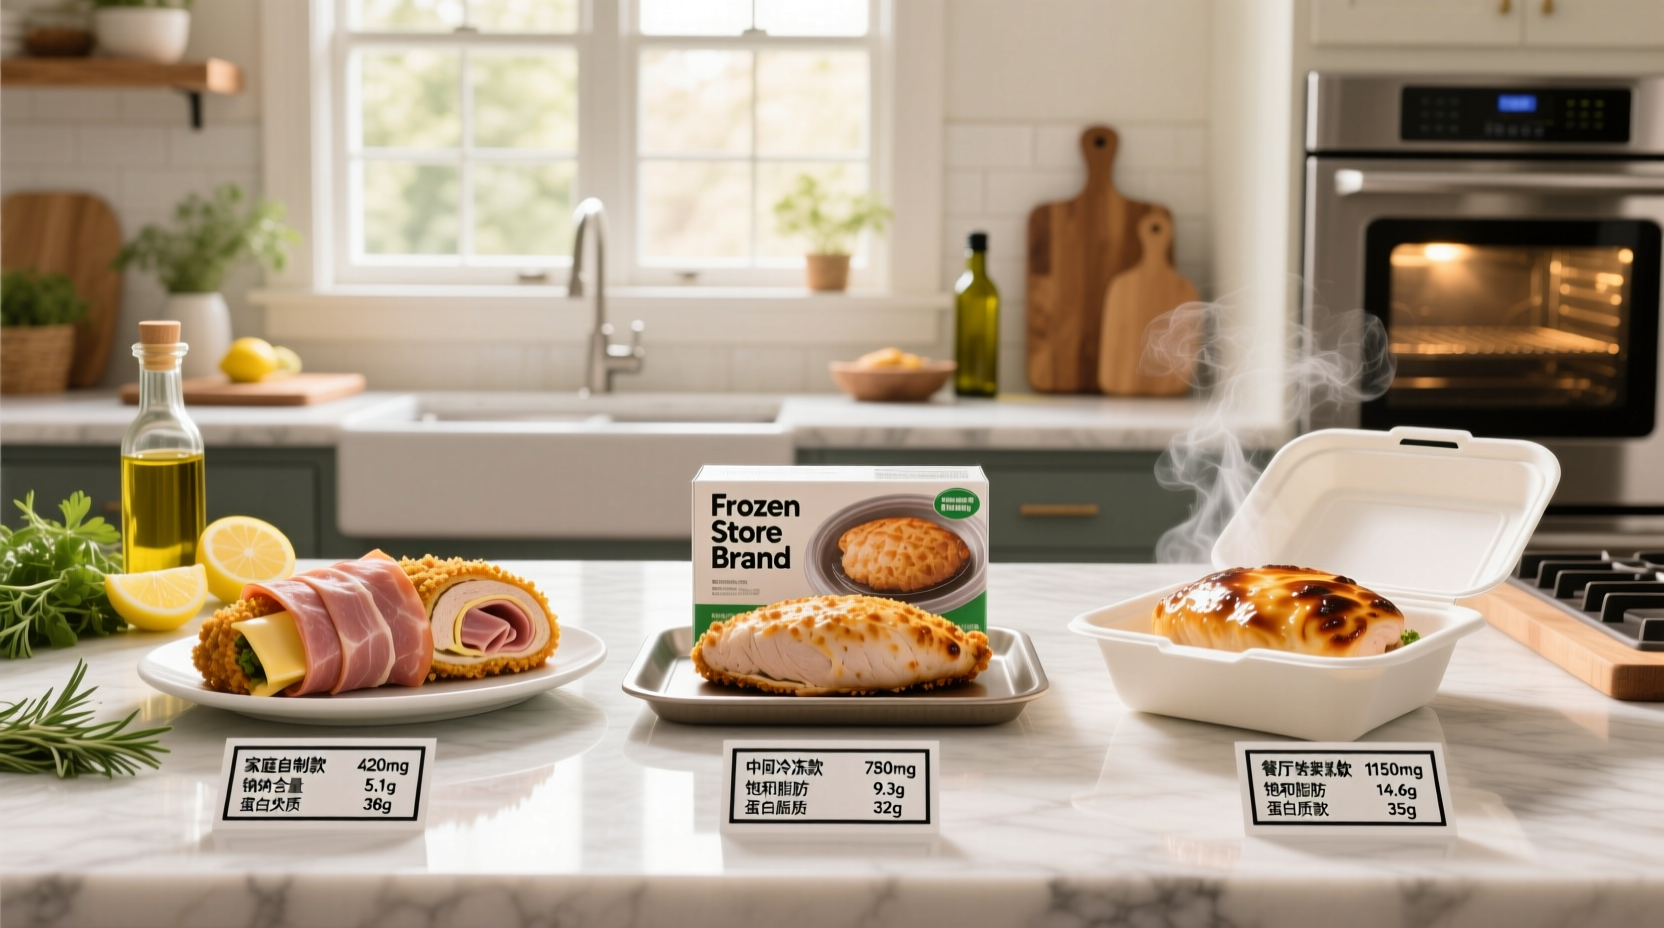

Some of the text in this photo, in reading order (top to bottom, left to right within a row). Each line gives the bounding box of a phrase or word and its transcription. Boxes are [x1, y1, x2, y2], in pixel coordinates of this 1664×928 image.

[711, 493, 800, 517] Frozen
[711, 520, 782, 543] Store
[711, 546, 791, 569] Brand
[244, 757, 409, 775] 家庭自制款 420mg
[1365, 762, 1423, 779] 1150mg
[364, 778, 396, 795] 5.1g
[873, 782, 905, 798] 9.3g
[1376, 784, 1417, 799] 14.6g
[363, 798, 391, 814] 36g
[873, 801, 902, 818] 32g
[1388, 803, 1416, 819] 35g
